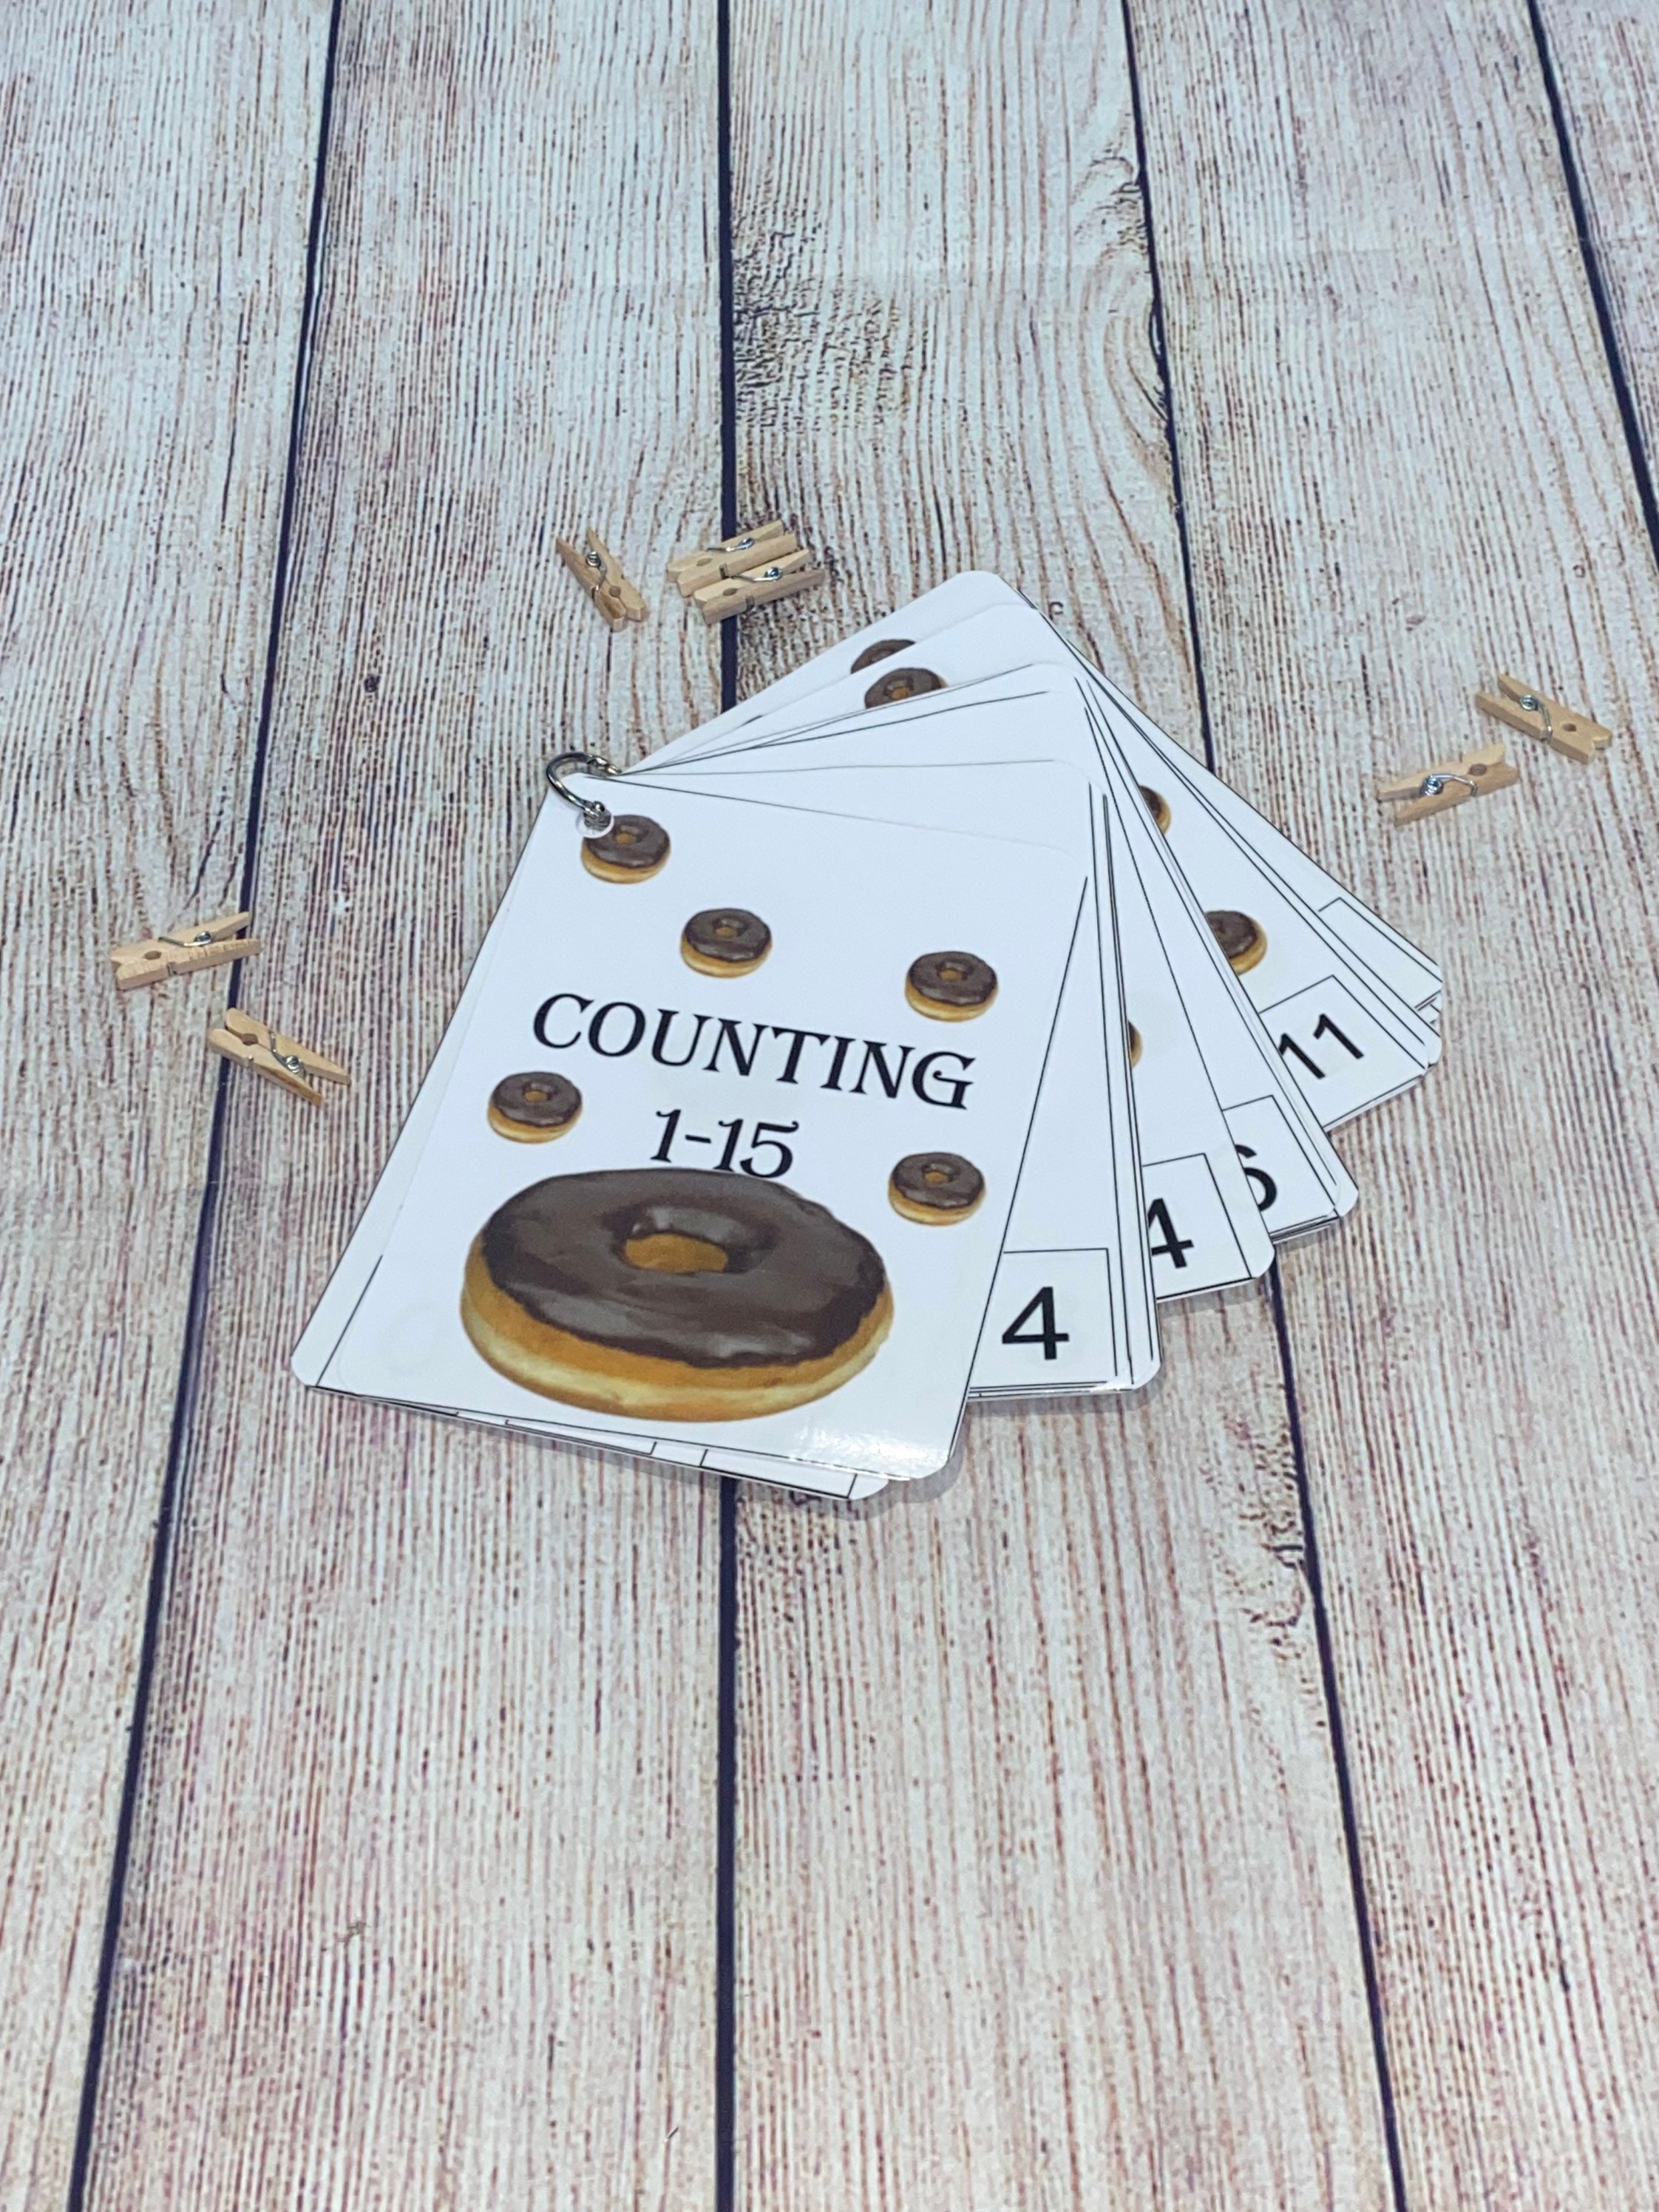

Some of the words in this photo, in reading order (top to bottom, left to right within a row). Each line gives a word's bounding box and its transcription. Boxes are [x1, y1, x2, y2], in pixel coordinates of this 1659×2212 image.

[532, 993, 977, 1110] COUNTING
[1278, 1014, 1365, 1079] 11
[650, 1108, 798, 1178] 1-15
[1147, 1198, 1194, 1269] 4
[1001, 1286, 1069, 1360] 4
